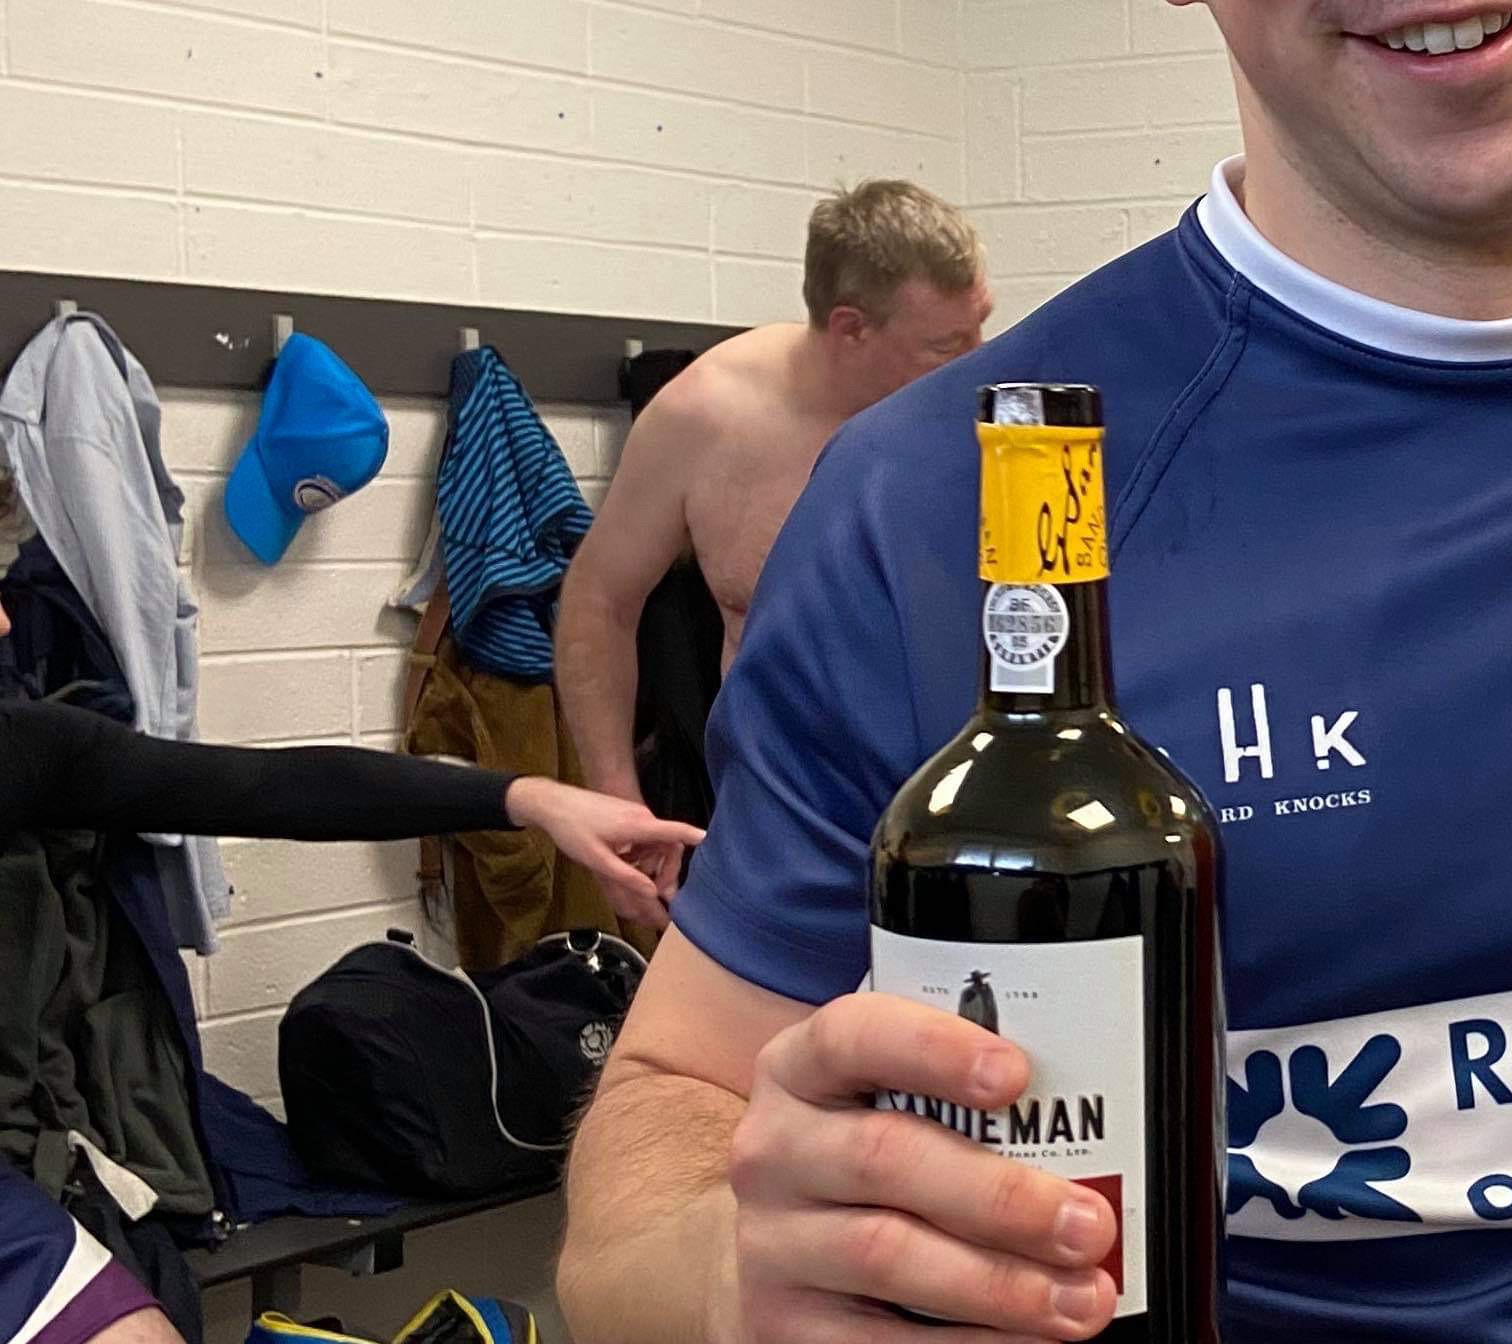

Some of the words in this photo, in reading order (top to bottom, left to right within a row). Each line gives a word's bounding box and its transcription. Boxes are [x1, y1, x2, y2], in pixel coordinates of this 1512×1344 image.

[1217, 683, 1273, 783] H
[1311, 711, 1367, 770] K
[1274, 789, 1371, 815] KNOCKS
